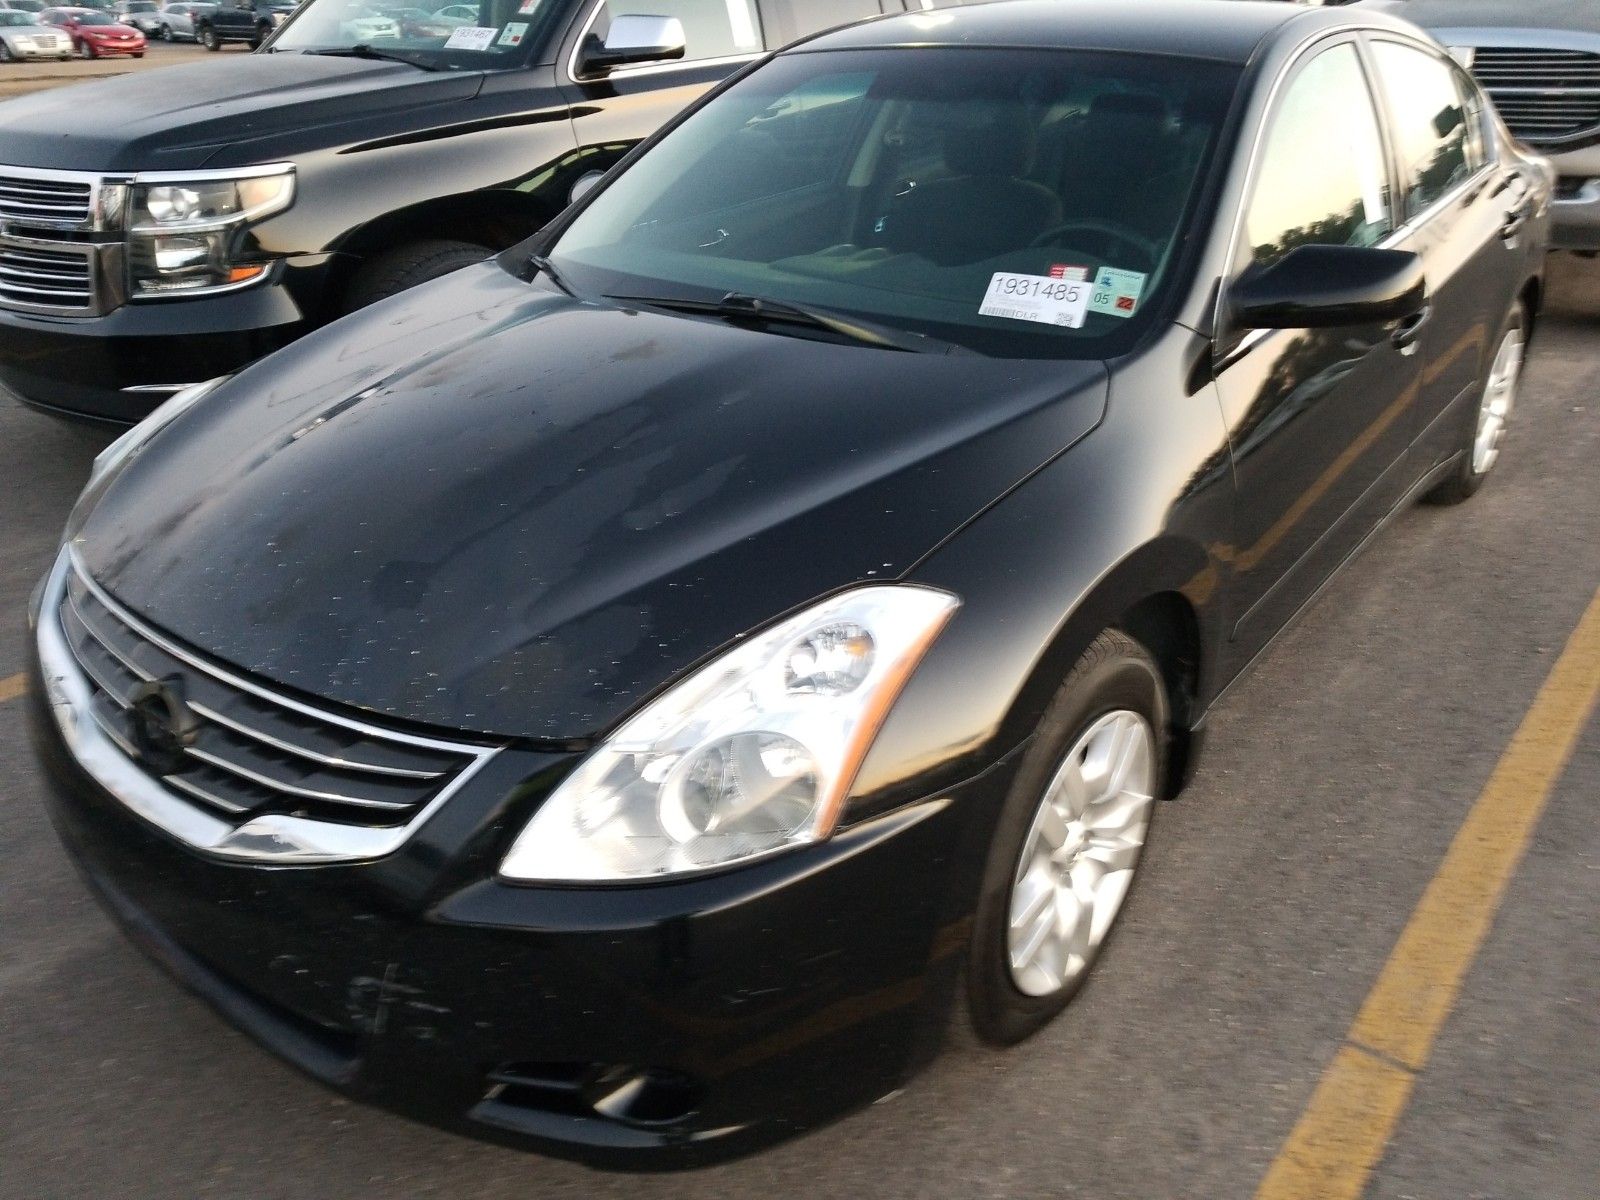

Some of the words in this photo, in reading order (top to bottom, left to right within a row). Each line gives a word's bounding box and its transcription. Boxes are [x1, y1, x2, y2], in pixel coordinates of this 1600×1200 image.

[995, 277, 1081, 303] 1931485
[1094, 292, 1110, 305] 05
[1117, 296, 1135, 310] 22
